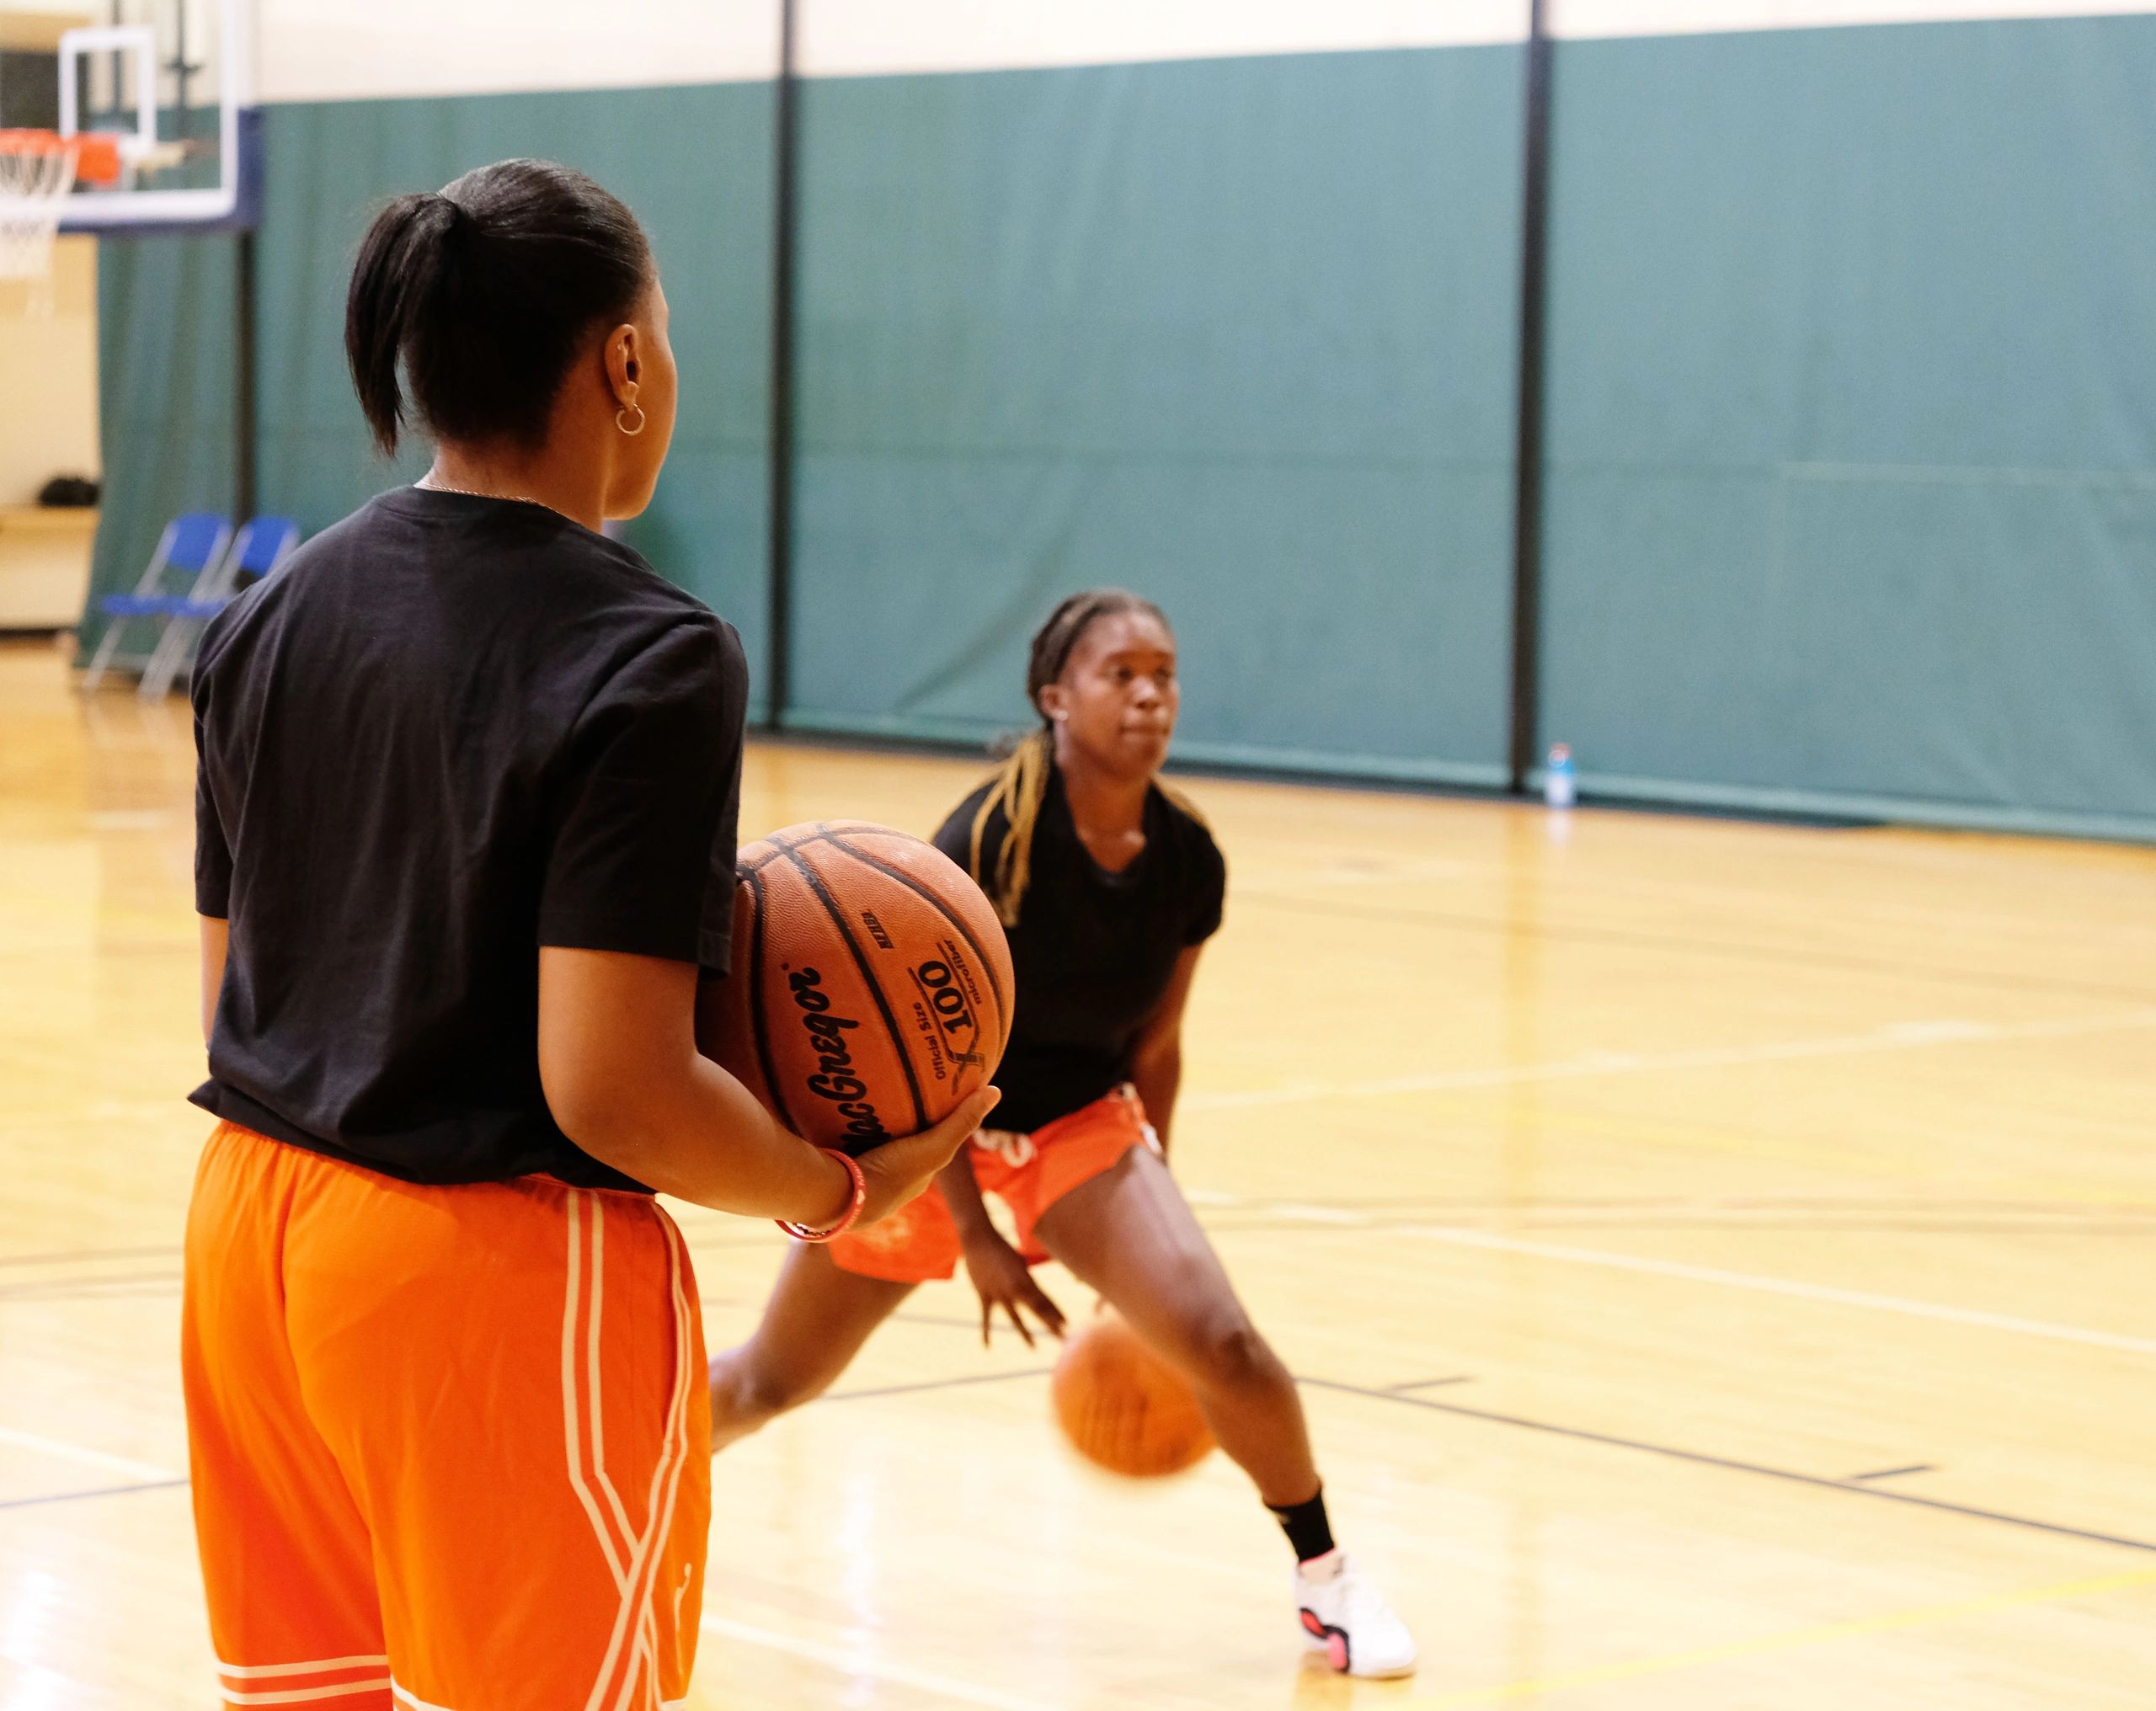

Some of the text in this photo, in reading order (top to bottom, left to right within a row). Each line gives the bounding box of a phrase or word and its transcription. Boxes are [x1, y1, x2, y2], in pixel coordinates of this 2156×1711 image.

[943, 938, 982, 1005] microfiber
[913, 1002, 946, 1080] Official Size
